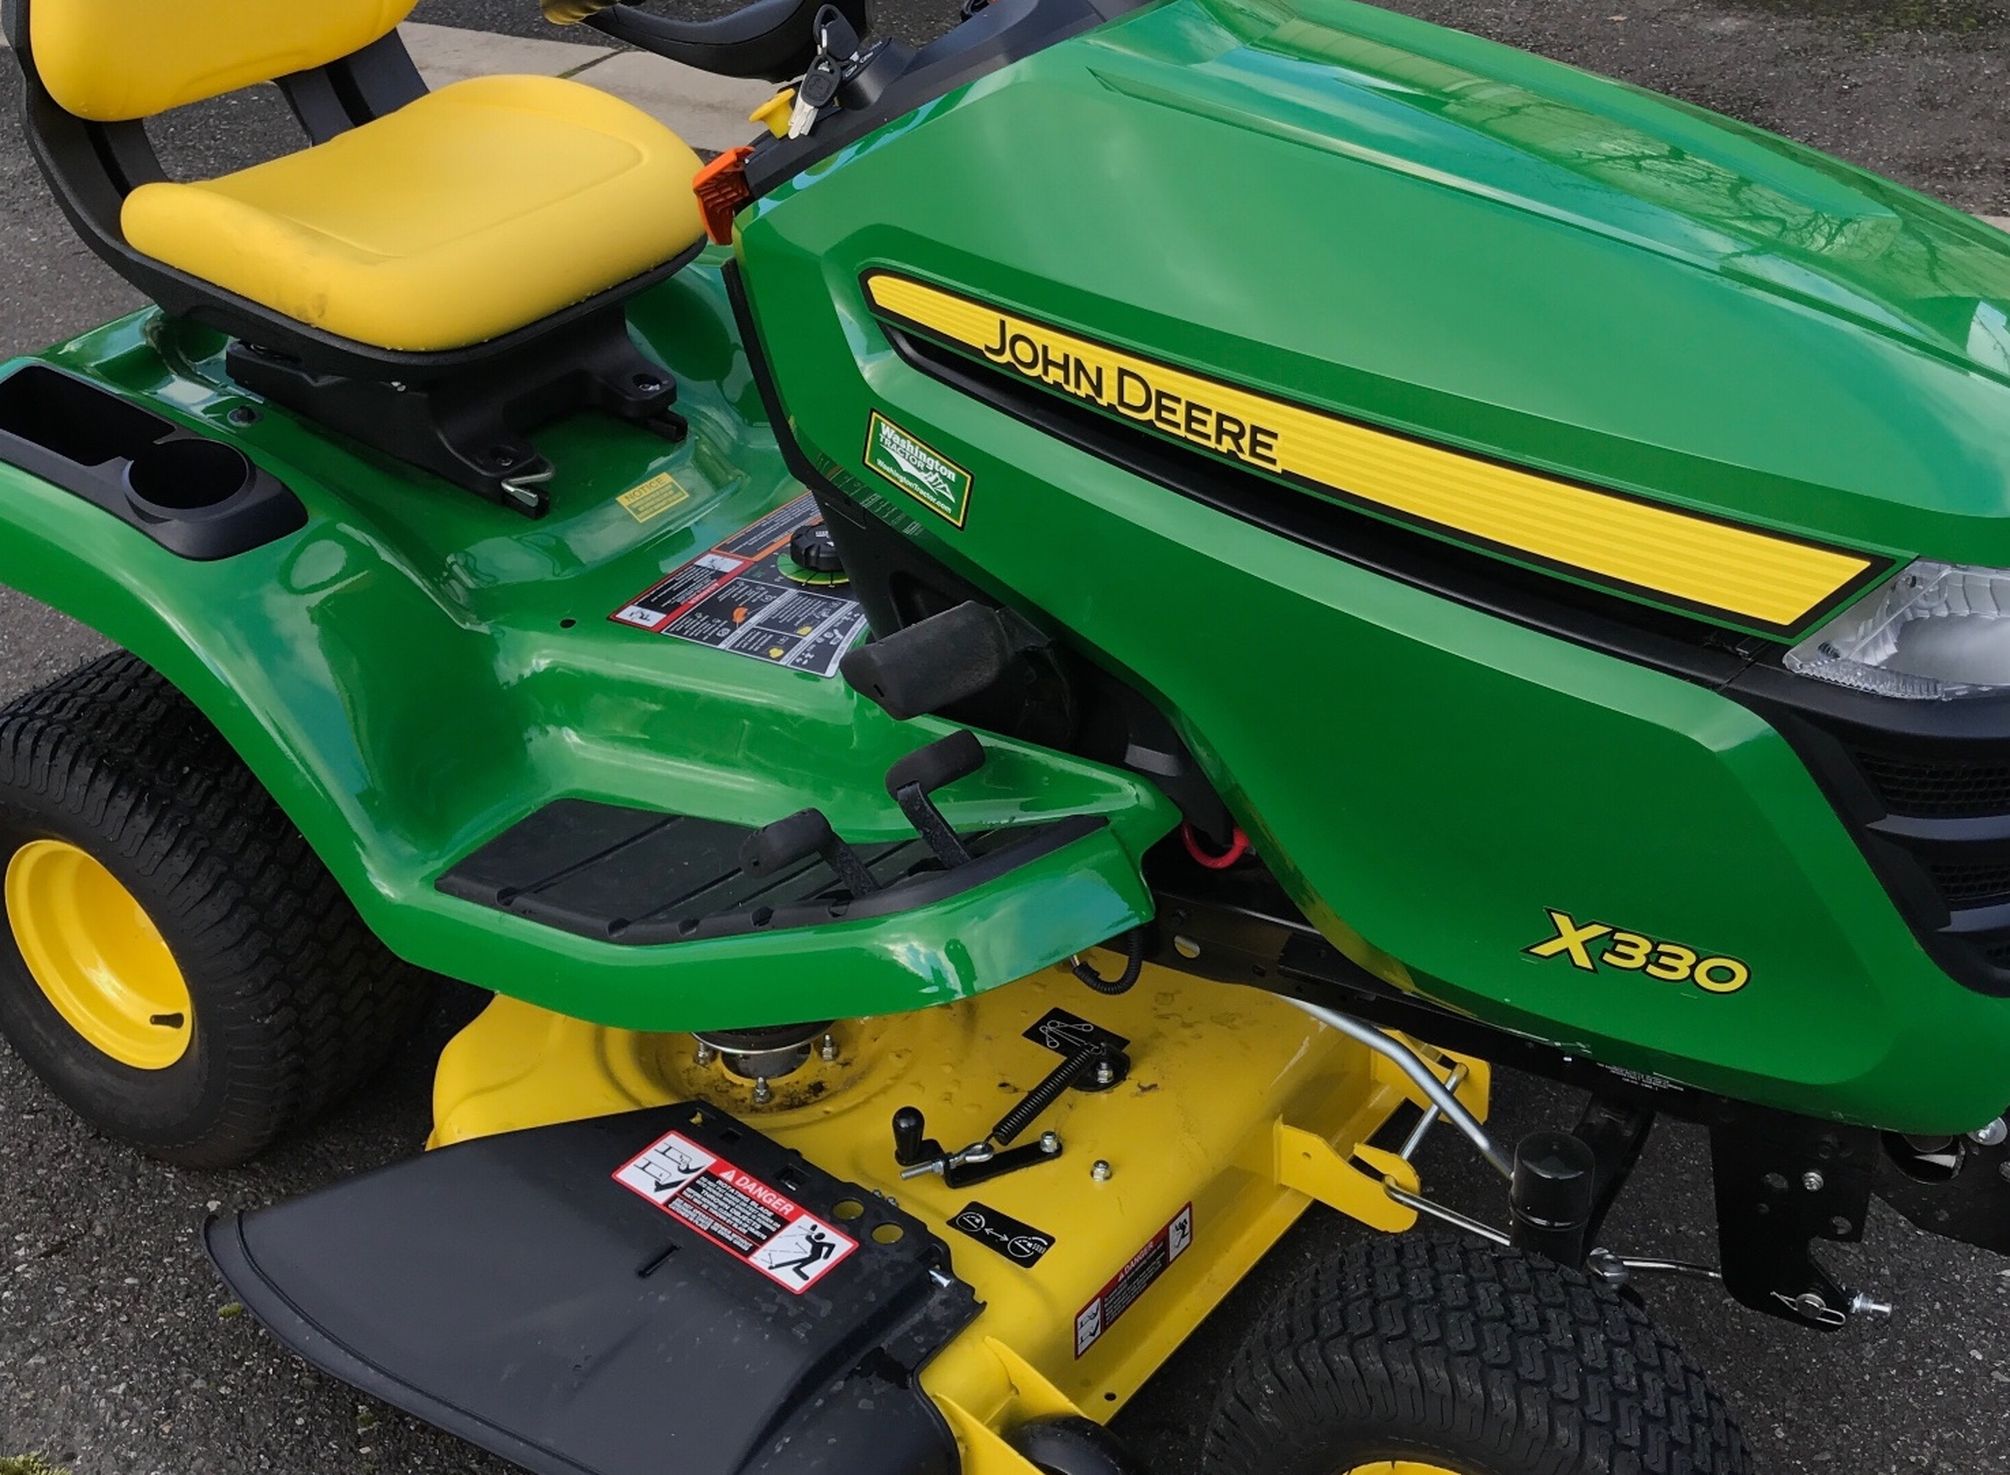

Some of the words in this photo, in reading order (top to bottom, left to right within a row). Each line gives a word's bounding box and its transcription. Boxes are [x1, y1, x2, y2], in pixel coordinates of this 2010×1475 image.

[984, 319, 1103, 400] JOHN
[1117, 366, 1279, 466] DEERE
[879, 432, 926, 471] TRACTOR
[880, 421, 956, 482] Washington
[624, 476, 665, 502] NOTICE
[876, 458, 952, 514] WashingtonTractor.com
[1521, 906, 1751, 994] X330
[735, 1176, 794, 1215] DANGER
[1124, 1241, 1153, 1275] DANGER
